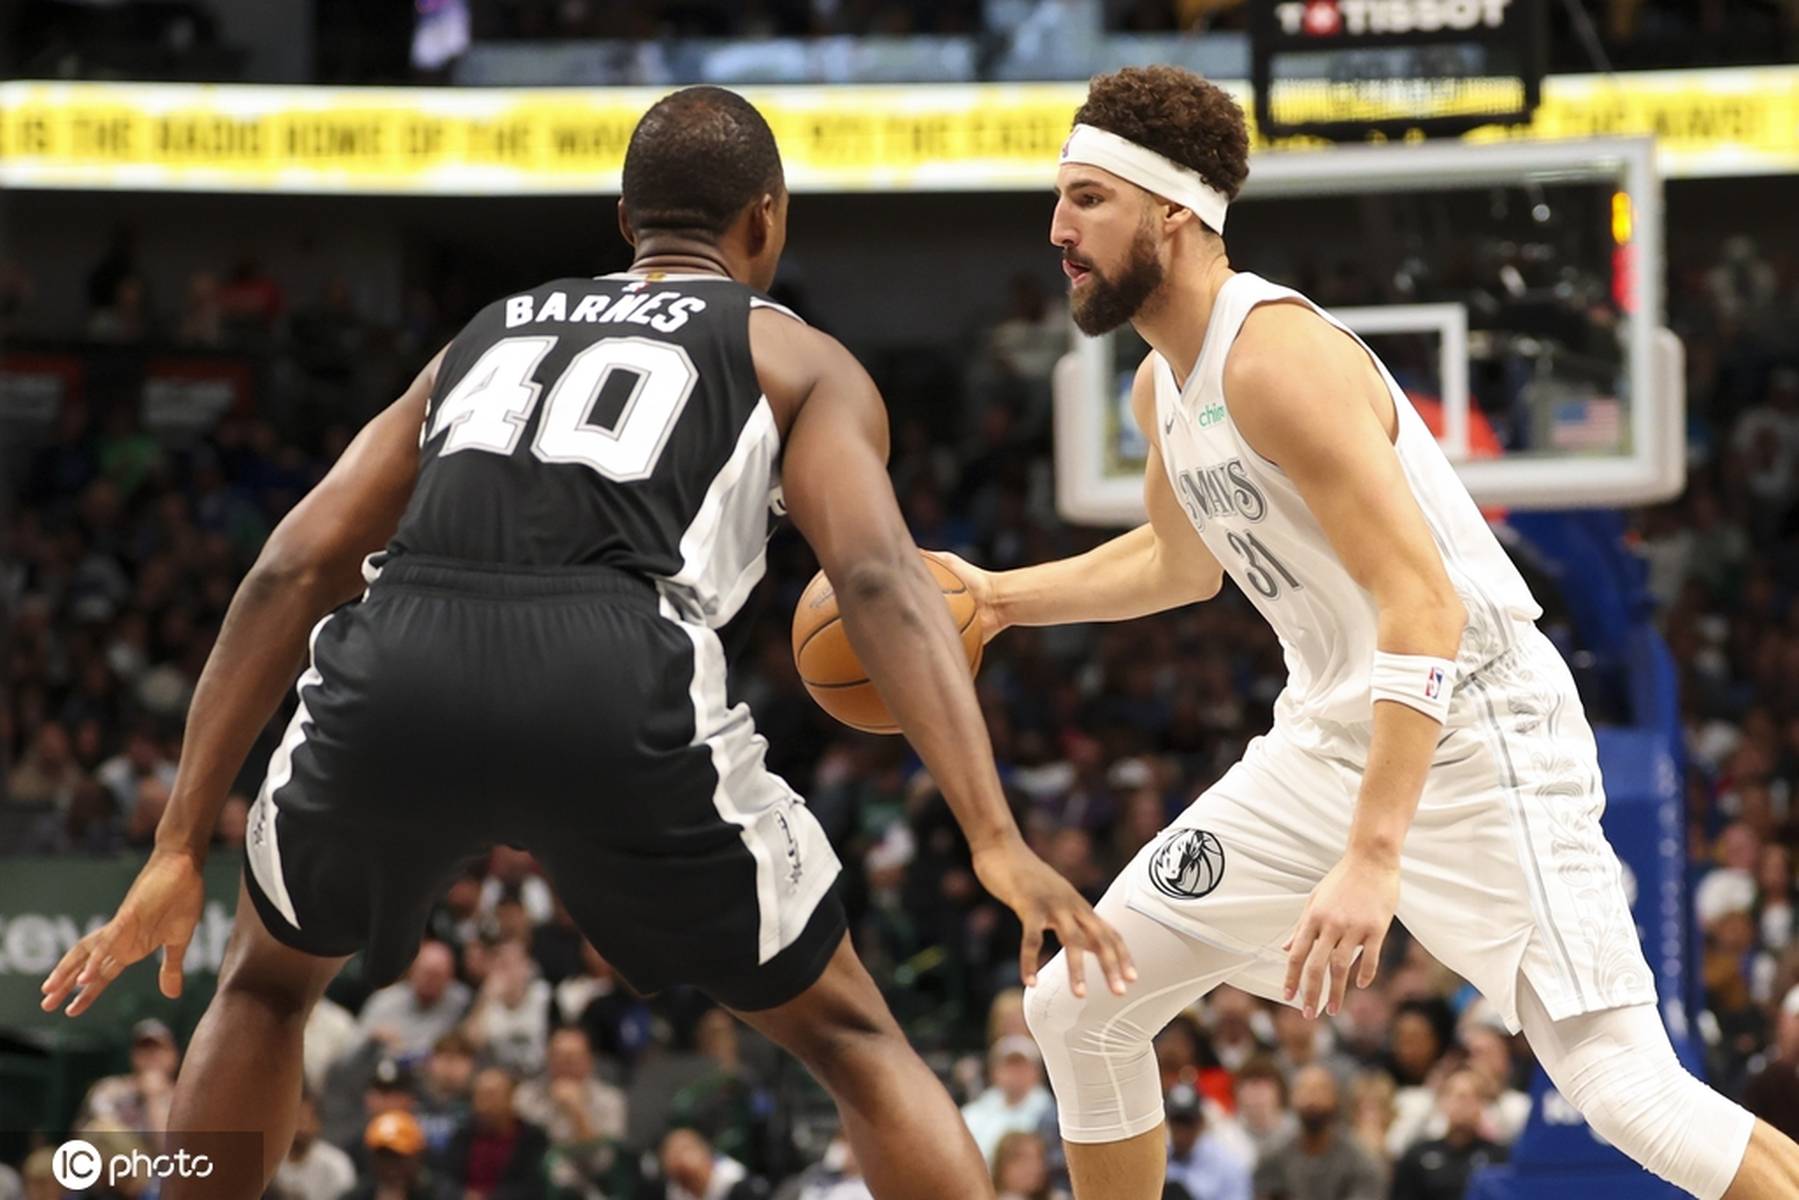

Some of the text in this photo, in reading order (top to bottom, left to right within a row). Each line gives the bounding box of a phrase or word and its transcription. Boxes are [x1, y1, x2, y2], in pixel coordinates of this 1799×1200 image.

[1341, 0, 1512, 35] TISSOT
[506, 292, 706, 333] BARNES
[427, 336, 699, 483] 40
[1226, 529, 1303, 600] 31
